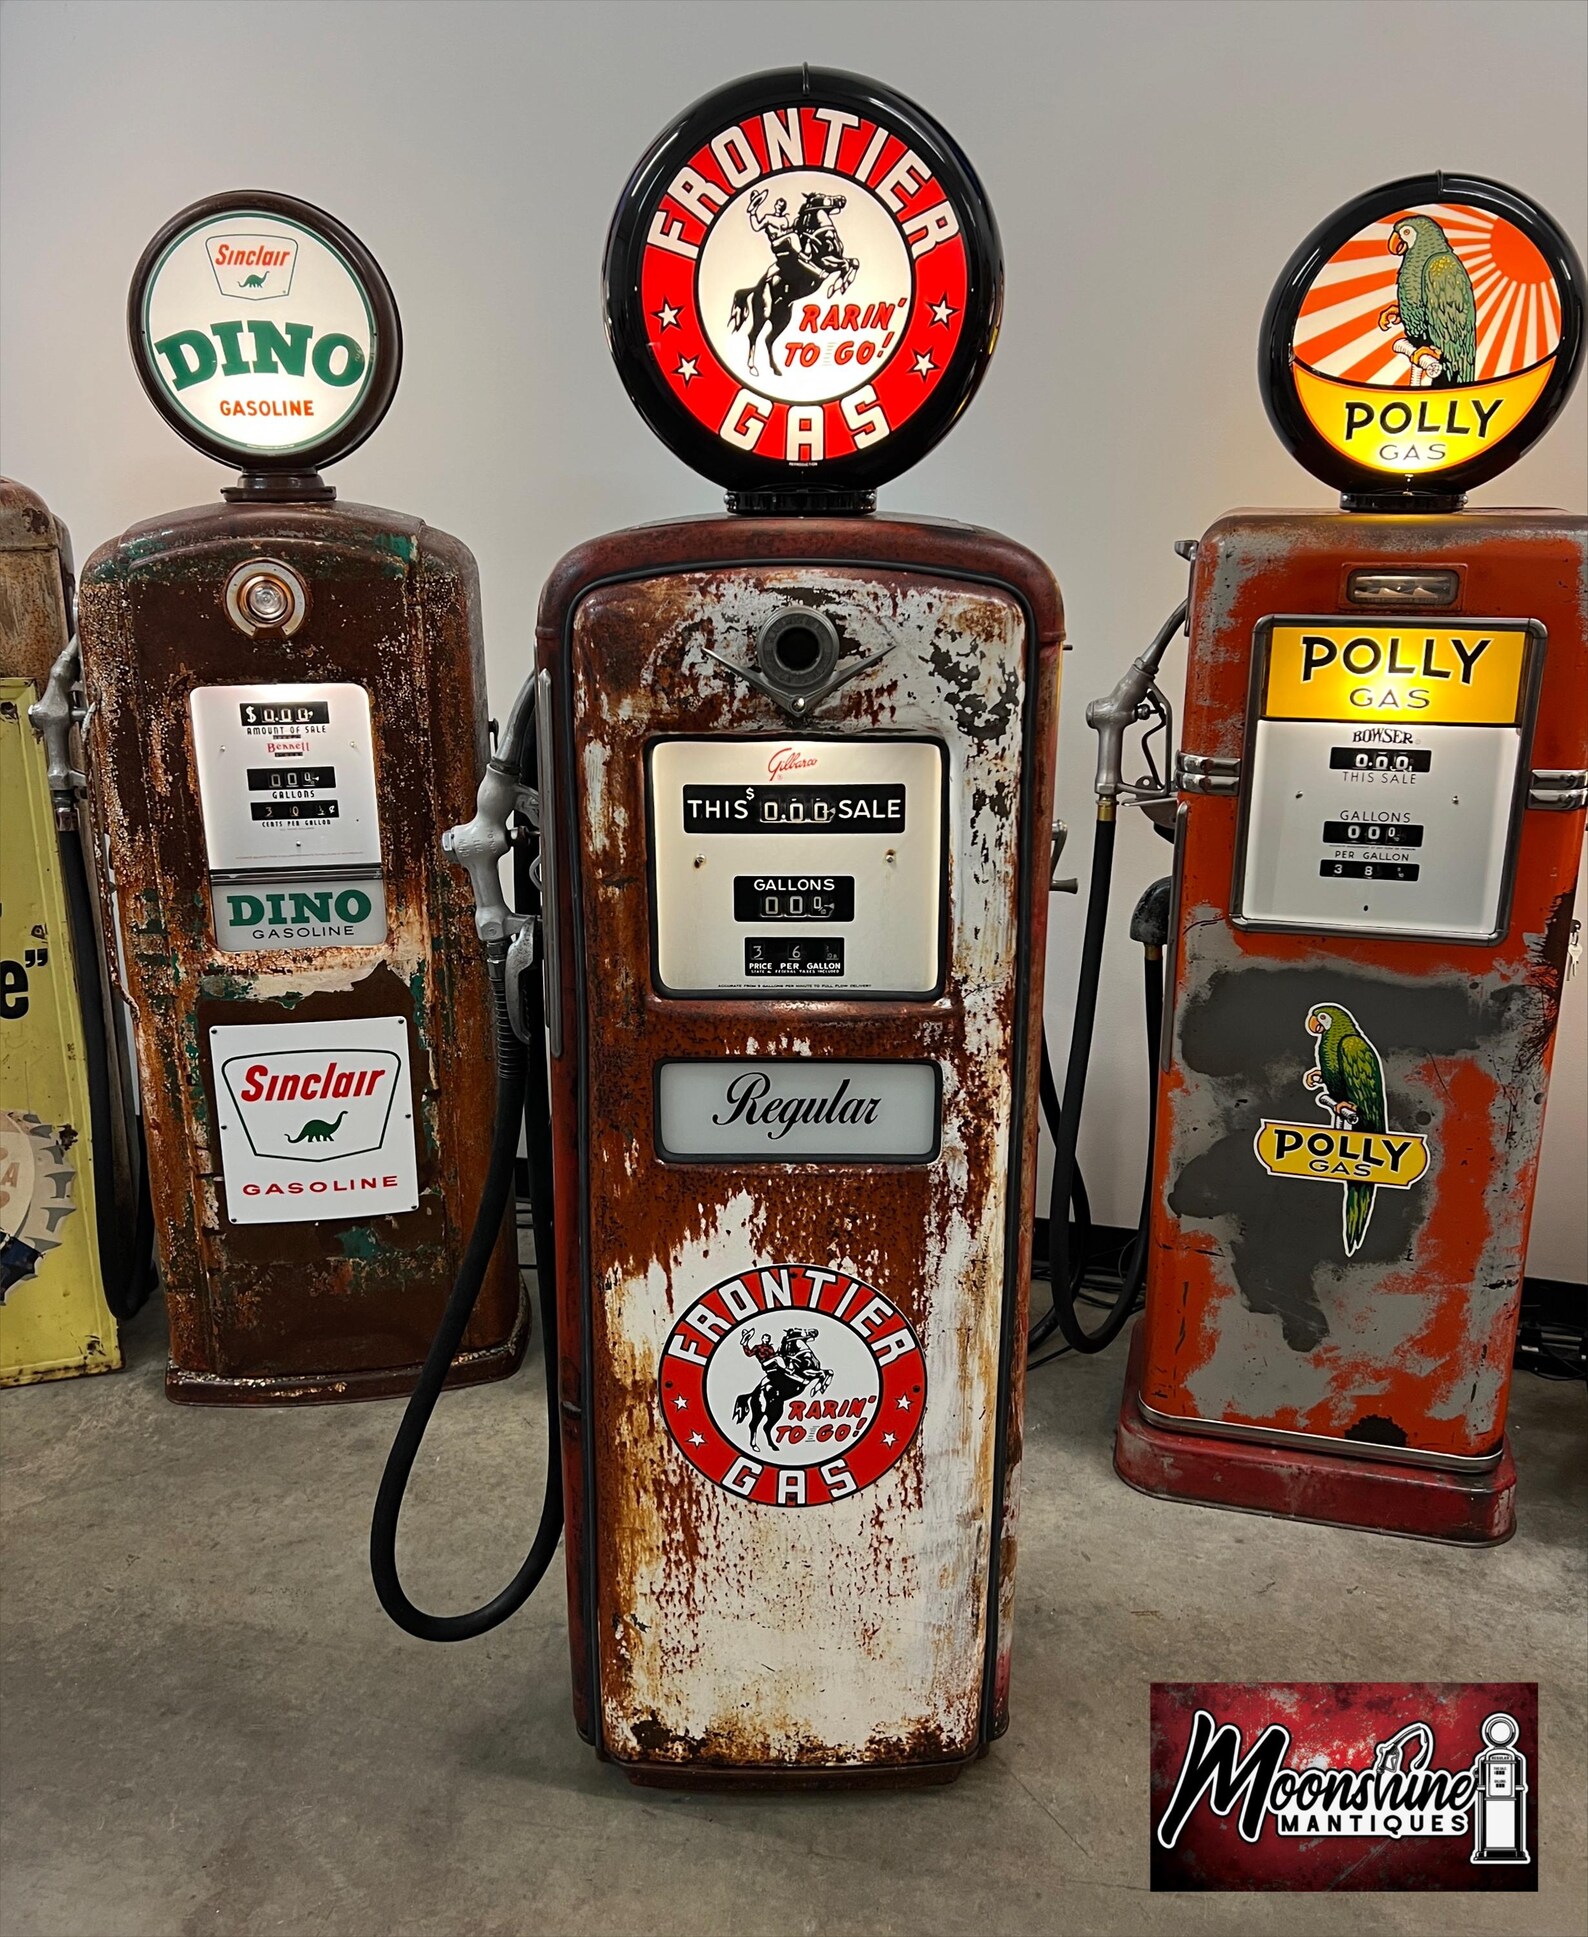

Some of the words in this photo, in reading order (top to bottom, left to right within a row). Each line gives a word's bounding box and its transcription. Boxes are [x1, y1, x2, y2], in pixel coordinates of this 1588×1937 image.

[648, 107, 960, 260] FRONTIER
[215, 244, 290, 267] Sinclair
[799, 298, 907, 334] RARIN'
[154, 320, 365, 392] DINO
[784, 341, 819, 368] TO
[834, 331, 893, 367] GO!
[220, 400, 314, 416] GASOLINE
[719, 383, 891, 461] GAS
[1345, 399, 1504, 441] POLLY
[1379, 444, 1446, 461] GAS
[1301, 636, 1491, 684] POLLY
[1349, 688, 1431, 710] GAS
[246, 727, 284, 736] AMOUNT
[290, 726, 301, 735] OF
[305, 725, 327, 734] SALE
[1352, 727, 1414, 745] BOWSER
[768, 747, 818, 782] Gilbarco
[1343, 771, 1375, 783] THIS
[1381, 773, 1417, 785] SALE
[272, 789, 315, 800] GALLONS
[687, 800, 749, 819] THIS
[838, 800, 901, 819] SALE
[1339, 809, 1411, 824] GALLONS
[261, 820, 283, 828] CENTS
[305, 818, 331, 826] GALLON
[1335, 850, 1355, 859] PER
[1362, 851, 1410, 862] GALLON
[753, 878, 836, 892] GALLONS
[226, 889, 372, 927] DINO
[252, 925, 355, 940] GASOLINE
[749, 962, 773, 970] PRICE
[780, 962, 800, 970] PER
[806, 962, 841, 970] GALLON
[241, 1062, 386, 1103] Sinclair
[712, 1072, 882, 1140] Regular
[1274, 1129, 1412, 1173] POLLY
[1309, 1160, 1372, 1177] GAS
[242, 1175, 398, 1196] GASOLINE
[668, 1268, 916, 1367] FRONTIER
[788, 1395, 877, 1422] RARIN'
[775, 1425, 807, 1444] TO
[815, 1416, 868, 1443] GO!
[721, 1456, 858, 1505] GAS
